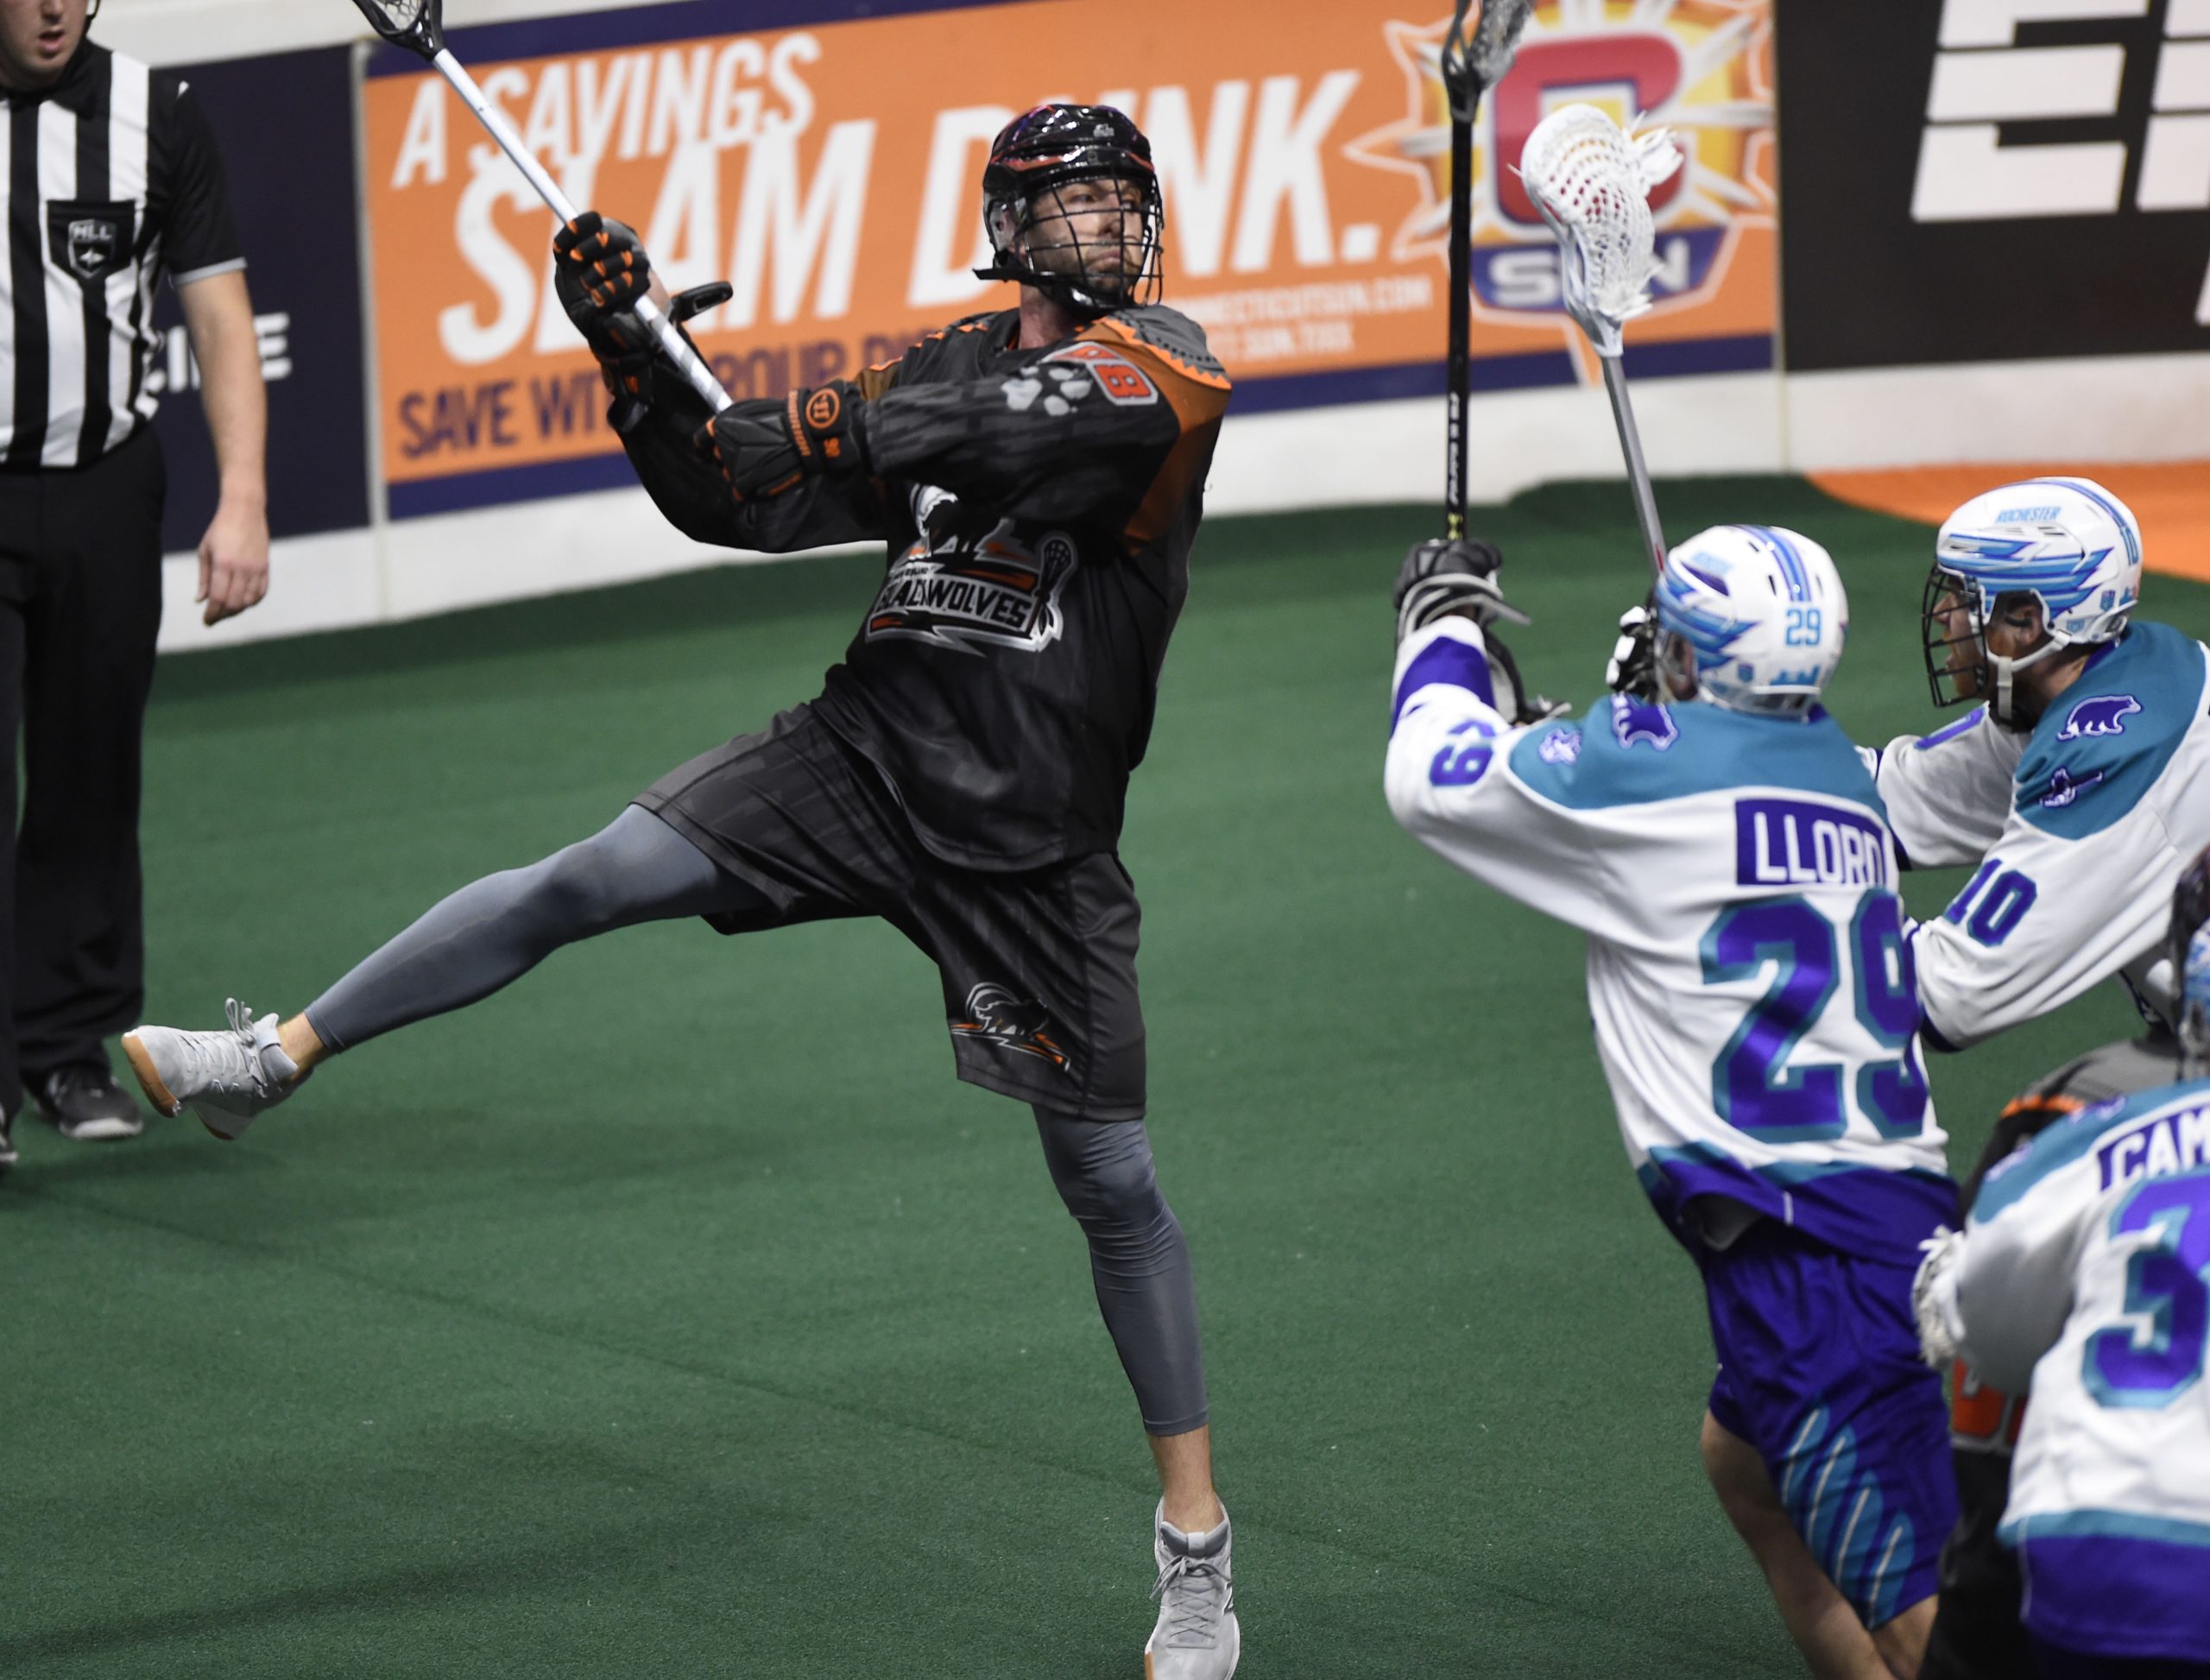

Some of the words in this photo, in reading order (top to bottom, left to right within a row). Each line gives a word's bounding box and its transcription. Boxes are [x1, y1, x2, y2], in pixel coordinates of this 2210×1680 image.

[390, 78, 447, 189] A
[467, 32, 821, 173] SAVINGS
[906, 69, 1380, 309] DNK.
[397, 378, 519, 462] SAVE
[1784, 608, 1822, 647] 29
[1942, 857, 2038, 948] 10
[1698, 887, 1929, 1145] 29
